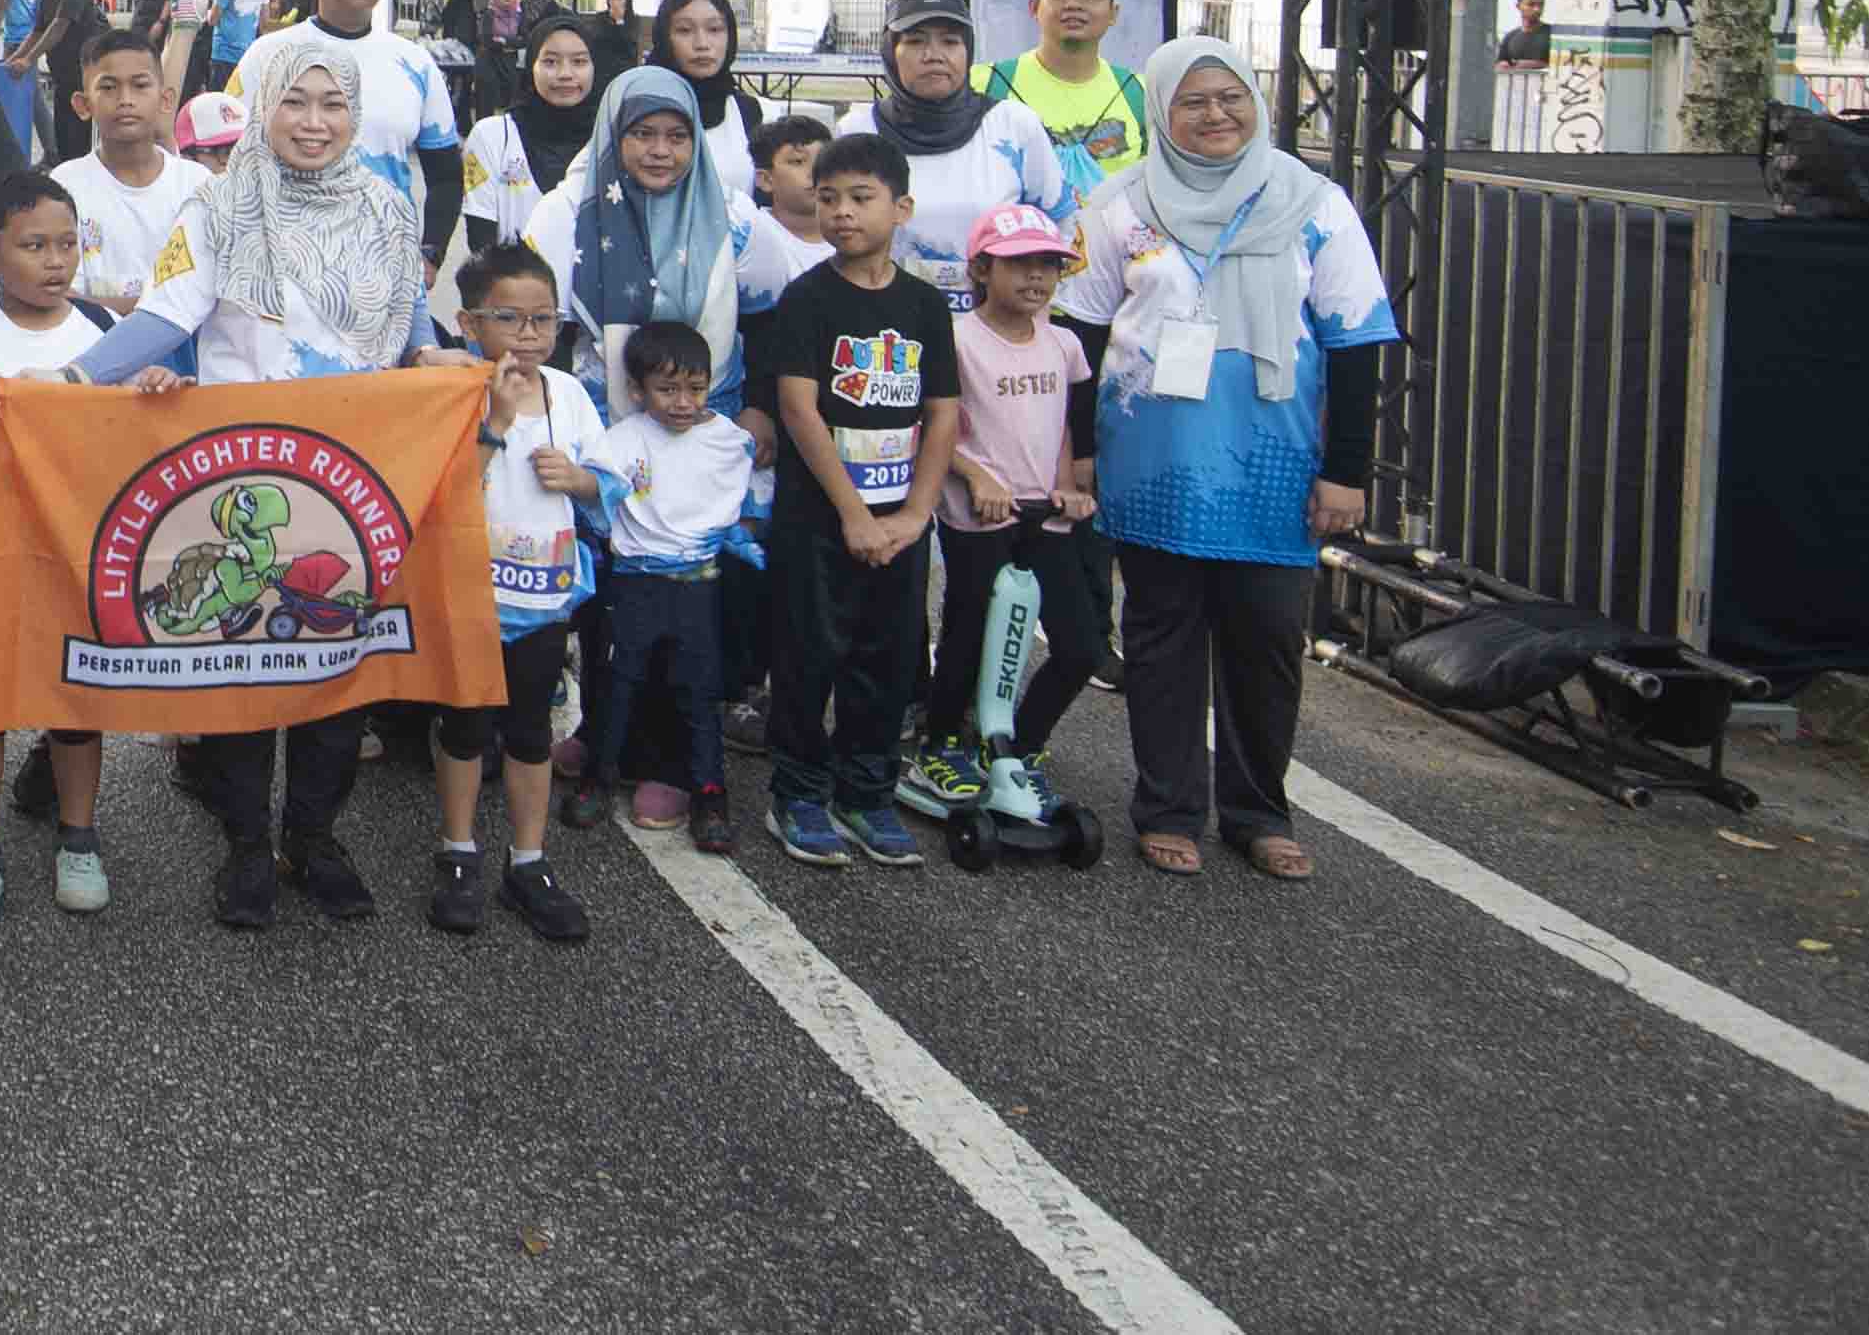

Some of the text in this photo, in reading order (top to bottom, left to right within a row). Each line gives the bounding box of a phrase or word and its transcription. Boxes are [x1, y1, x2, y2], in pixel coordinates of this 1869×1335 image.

[947, 292, 973, 309] 20
[996, 371, 1060, 397] SISTER
[863, 463, 909, 486] 2019
[101, 435, 402, 600] LITTLE FIGHTER RUNNERS
[490, 563, 549, 591] 2003
[78, 653, 182, 675] PERSATUAN
[192, 652, 251, 673] PELARI
[261, 651, 307, 670] ANAK
[996, 603, 1028, 702] SKIDZO
